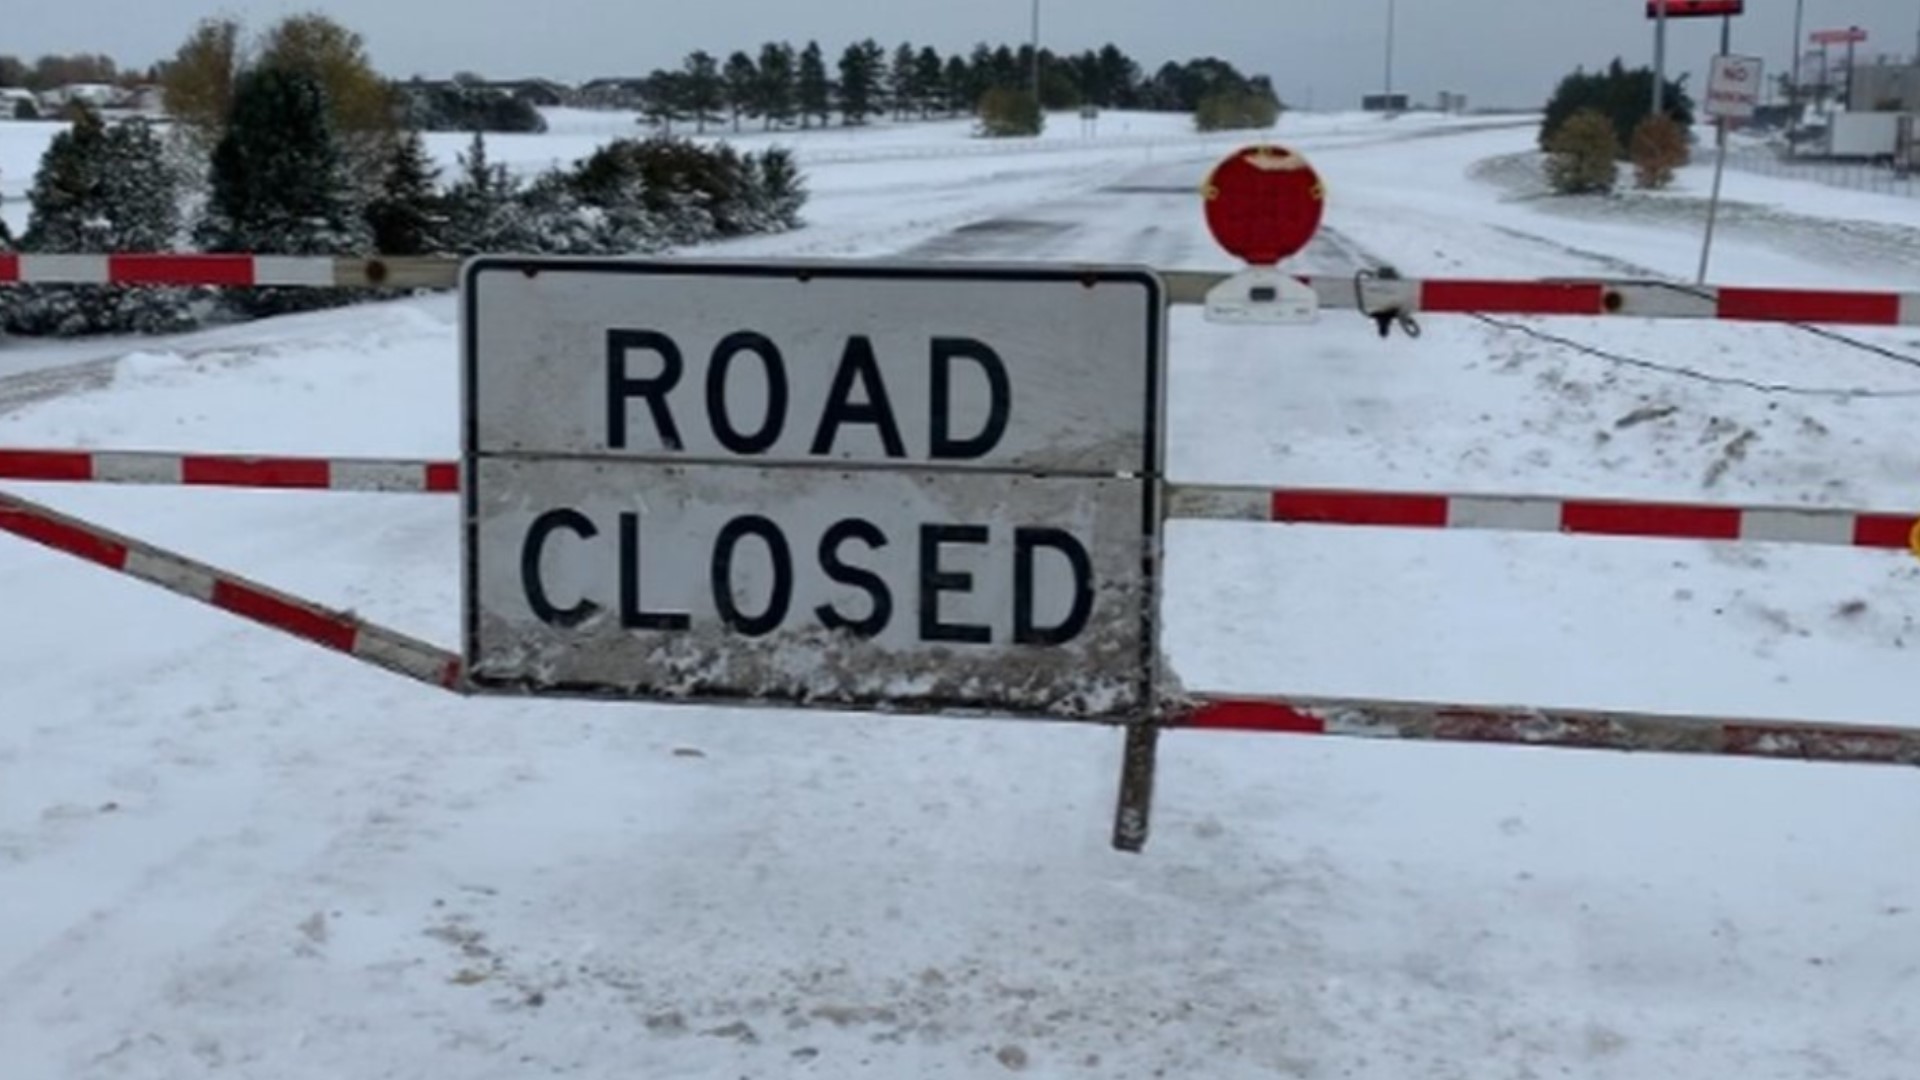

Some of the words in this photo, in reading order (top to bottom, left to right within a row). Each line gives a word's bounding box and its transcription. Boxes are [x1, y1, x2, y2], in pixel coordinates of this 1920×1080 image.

[1723, 67, 1749, 82] NO
[605, 329, 1011, 460] ROAD
[521, 507, 1094, 646] CLOSED
